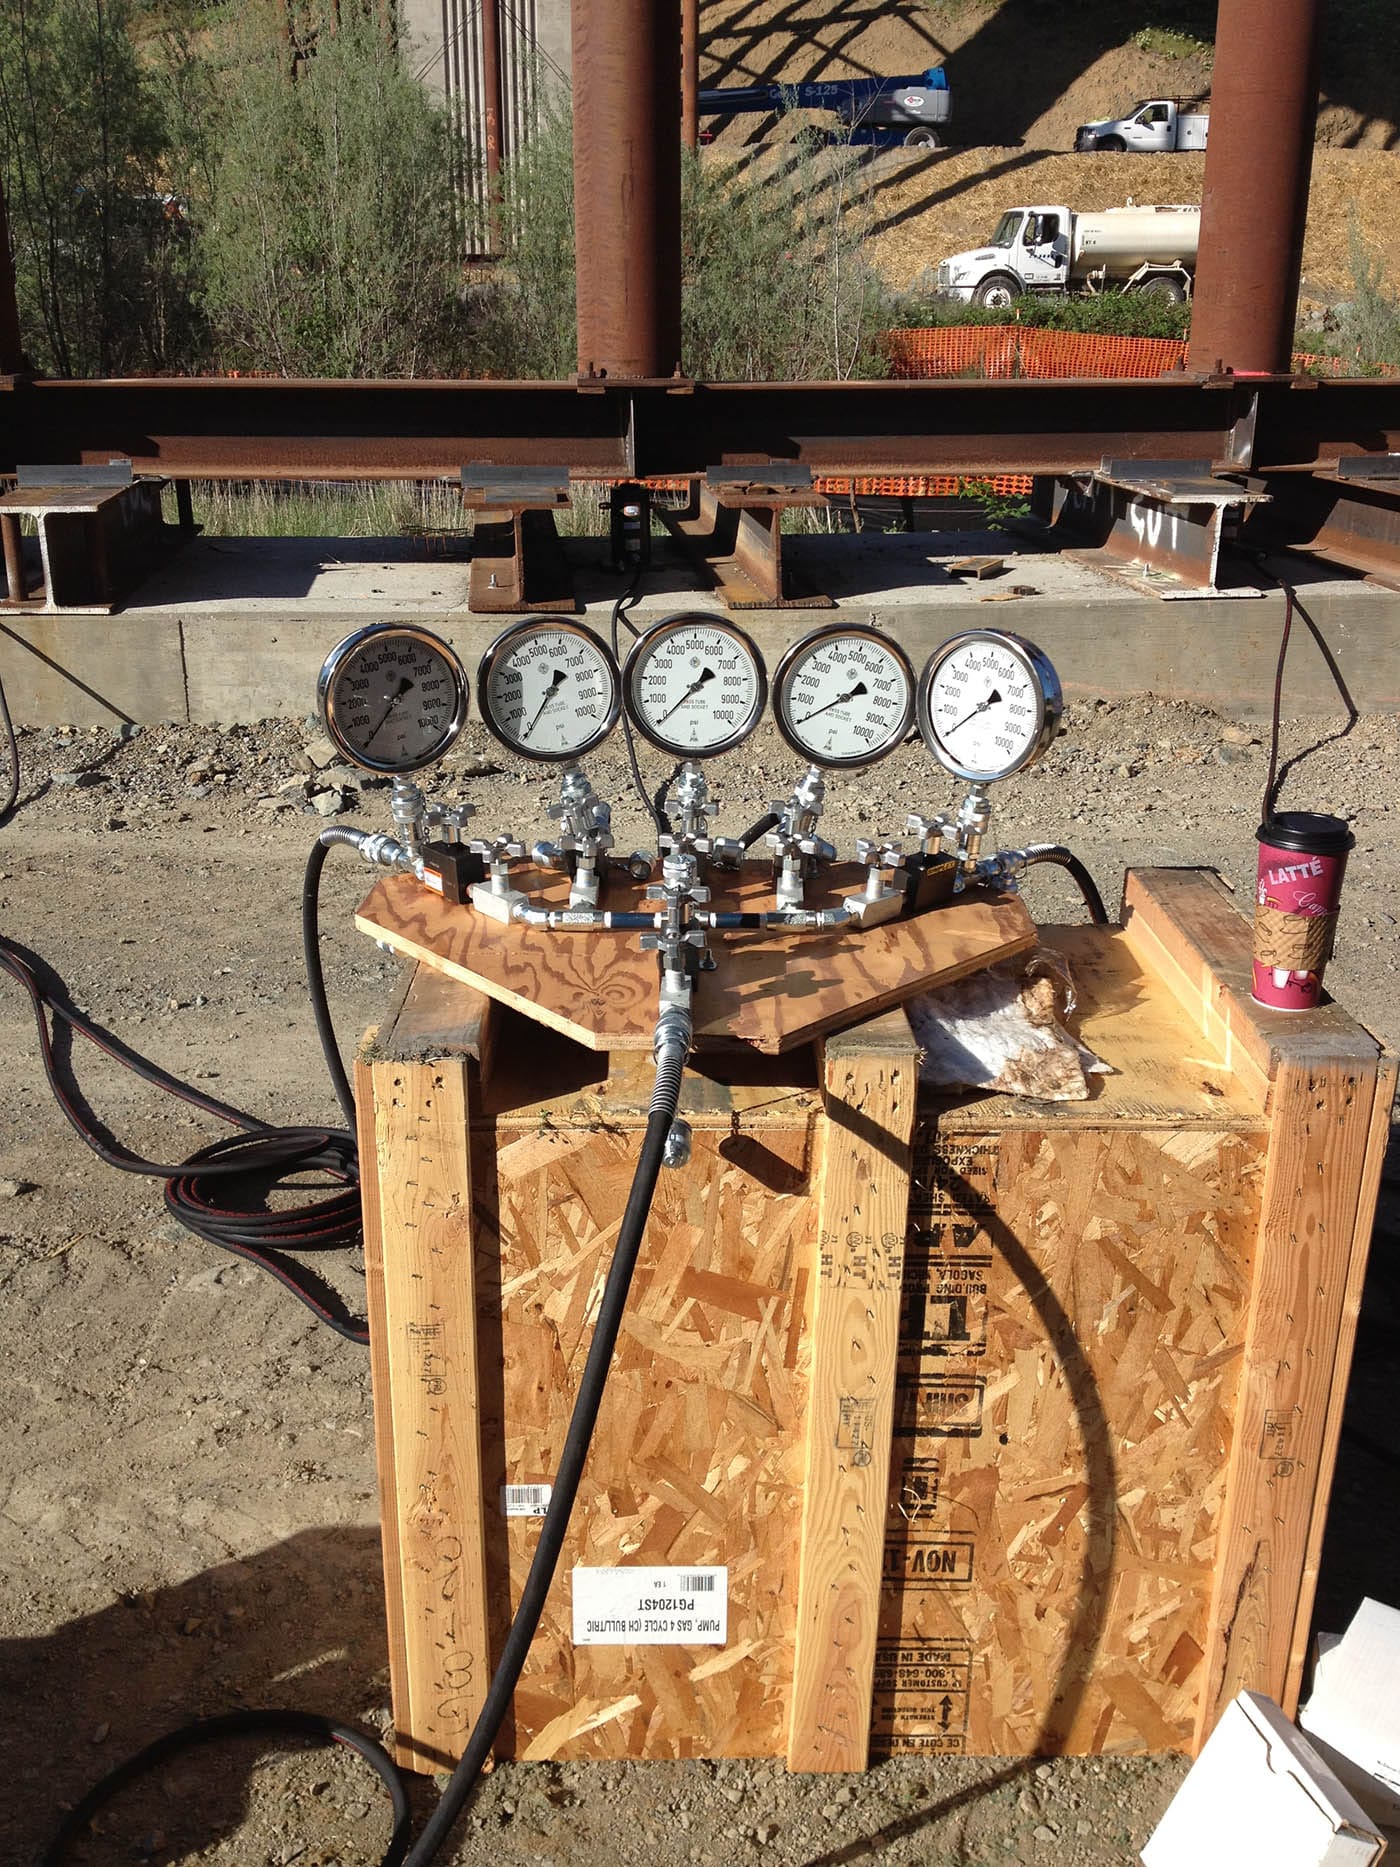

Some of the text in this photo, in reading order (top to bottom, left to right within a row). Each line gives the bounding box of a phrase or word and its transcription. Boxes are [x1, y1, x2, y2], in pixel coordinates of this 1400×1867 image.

[804, 84, 838, 97] S-125
[529, 645, 547, 657] 5000
[549, 645, 567, 657] 6000
[667, 646, 685, 655] 4000
[686, 640, 704, 650] 5000
[705, 646, 723, 655] 6000
[379, 653, 396, 664] 5000
[398, 654, 416, 665] 6000
[513, 655, 531, 667] 4000
[565, 655, 584, 668] 7000
[828, 651, 847, 664] 4000
[848, 651, 867, 664] 5000
[983, 657, 999, 670] 5000
[361, 662, 379, 673] 4000
[655, 659, 672, 669] 3000
[718, 660, 736, 669] 7000
[812, 661, 831, 673] 3000
[865, 661, 883, 674] 6000
[965, 659, 981, 671] 4000
[414, 665, 431, 677] 7000
[576, 670, 593, 682] 8000
[952, 670, 968, 683] 3000
[998, 667, 1014, 680] 6000
[504, 672, 522, 684] 3000
[649, 676, 666, 685] 2000
[724, 677, 741, 686] 8000
[801, 675, 820, 688] 2000
[352, 679, 369, 691] 3000
[422, 680, 439, 692] 8000
[873, 679, 892, 691] 7000
[503, 690, 520, 702] 2000
[578, 687, 596, 700] 9000
[945, 685, 960, 698] 2000
[1008, 685, 1024, 698] 7000
[423, 699, 440, 710] 9000
[650, 694, 666, 703] 1000
[722, 695, 739, 704] 9000
[798, 693, 814, 705] 1000
[873, 696, 892, 708] 8000
[510, 707, 527, 719] 1000
[575, 704, 596, 718] 10000
[713, 711, 733, 719] 10000
[944, 704, 957, 716] 1000
[1009, 704, 1026, 716] 8000
[353, 715, 370, 727] 1000
[418, 715, 438, 728] 10000
[865, 712, 884, 725] 9000
[853, 725, 874, 739] 10000
[1005, 722, 1021, 735] 9000
[995, 736, 1013, 750] 10000
[1268, 856, 1323, 886] LATTÉ
[853, 1256, 867, 1280] HT
[888, 1256, 902, 1280] HT
[638, 1599, 695, 1610] PG1204ST
[628, 1618, 642, 1632] (CH
[644, 1620, 668, 1632] CYCLE
[670, 1620, 675, 1631] 4
[677, 1620, 693, 1632] GAS
[695, 1619, 720, 1632] PUMP,
[901, 1653, 913, 1662] IN
[918, 1653, 951, 1662] MADE
[902, 1680, 948, 1688] CUSTOMER
[947, 1739, 960, 1748] CE
